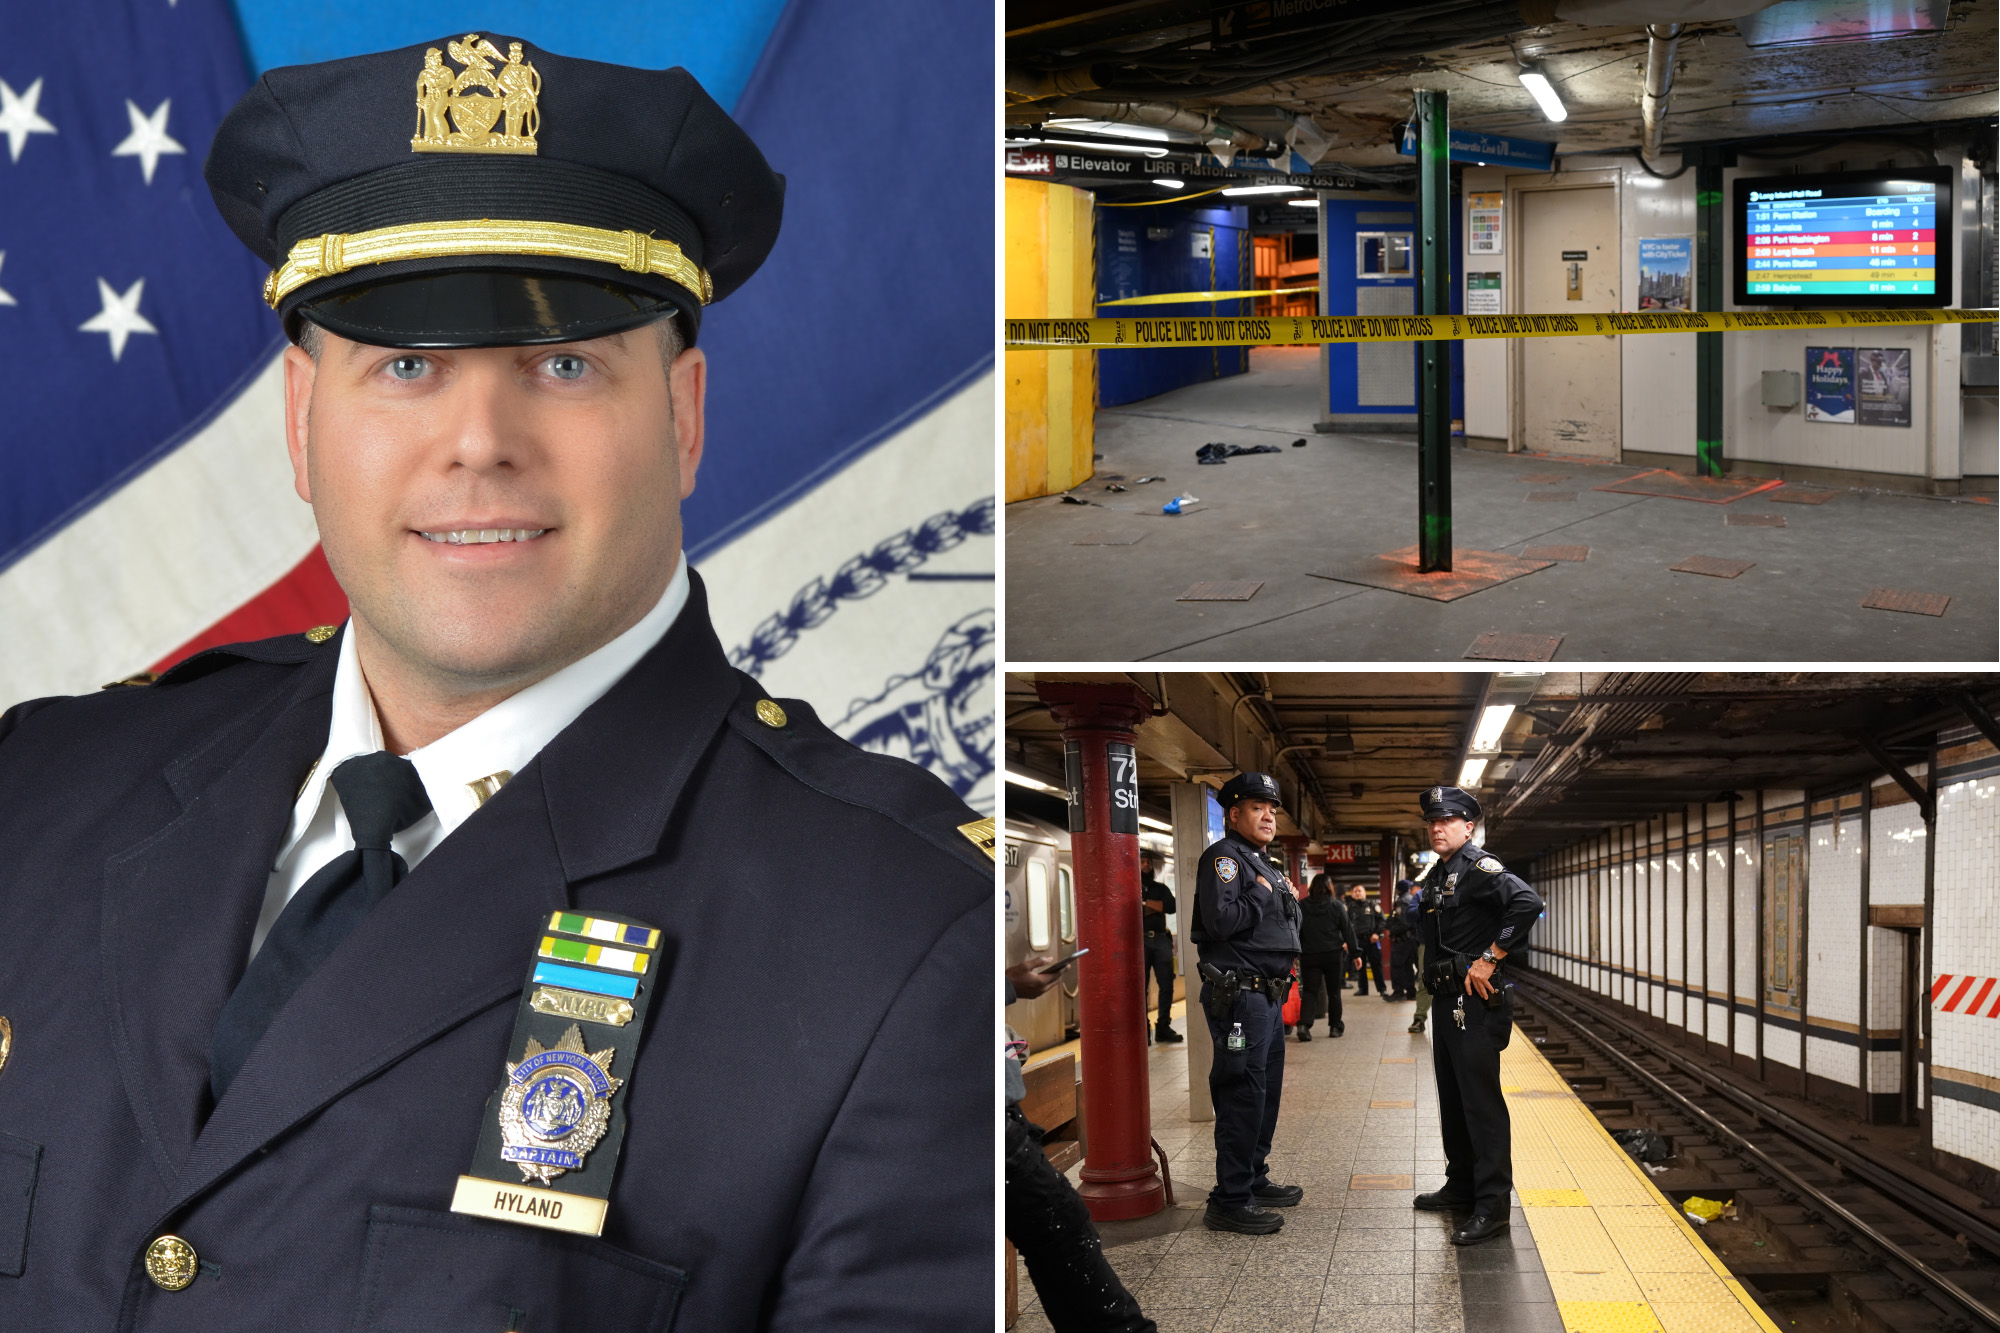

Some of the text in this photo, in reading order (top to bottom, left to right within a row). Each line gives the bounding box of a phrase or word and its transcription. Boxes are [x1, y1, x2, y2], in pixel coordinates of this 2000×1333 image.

[1273, 0, 1348, 17] MetroCar
[1450, 141, 1481, 152] aGuardia
[1006, 152, 1050, 173] Exit
[1071, 156, 1131, 172] Elevator
[1144, 160, 1176, 174] LIRR
[1772, 212, 1792, 220] Penn
[1792, 210, 1818, 220] Station
[1865, 207, 1901, 217] Boarding
[1912, 205, 1919, 214] 3
[1772, 223, 1802, 232] Jamaica
[1878, 219, 1894, 229] min
[1912, 218, 1919, 228] 4
[1772, 236, 1788, 244] Port
[1788, 235, 1830, 244] Washington
[1878, 232, 1894, 242] min
[1912, 232, 1919, 240] 2
[1772, 248, 1792, 258] Long
[1792, 247, 1815, 256] Beach
[1870, 245, 1880, 254] 11
[1881, 244, 1896, 254] min
[1912, 244, 1919, 253] 4
[1772, 260, 1792, 268] Penn
[1792, 259, 1818, 268] Station
[1881, 258, 1896, 266] min
[1912, 257, 1918, 266] 1
[1773, 272, 1813, 280] Hempstead
[1912, 270, 1918, 278] 4
[1772, 283, 1802, 294] Babylon
[1881, 283, 1896, 292] min
[1912, 283, 1919, 292] 4
[1312, 318, 1433, 338] POLICE LINE DO NOT CROSS
[1468, 316, 1578, 334] POLICE LINE DO NOT CROSS
[1607, 314, 1638, 330] POLICE
[1636, 314, 1656, 330] LINE
[1652, 314, 1668, 328] DO
[1666, 314, 1682, 328] NOT
[1680, 314, 1708, 328] CROSS
[1010, 322, 1090, 346] DO NOT CROSS
[1135, 321, 1172, 342] POLICE
[1174, 321, 1199, 342] LINE
[1200, 321, 1214, 341] DO
[1216, 320, 1235, 341] NOT
[1238, 320, 1271, 340] CROSS
[1812, 374, 1848, 386] Holidays
[1816, 366, 1844, 377] Happy
[1112, 757, 1137, 784] 72
[1068, 786, 1078, 806] et
[1114, 788, 1138, 809] Str
[516, 1053, 607, 1091] CITY OF NEW YORK POLICE
[508, 1146, 575, 1165] CAPTAIN
[494, 1191, 563, 1220] HYLAND
